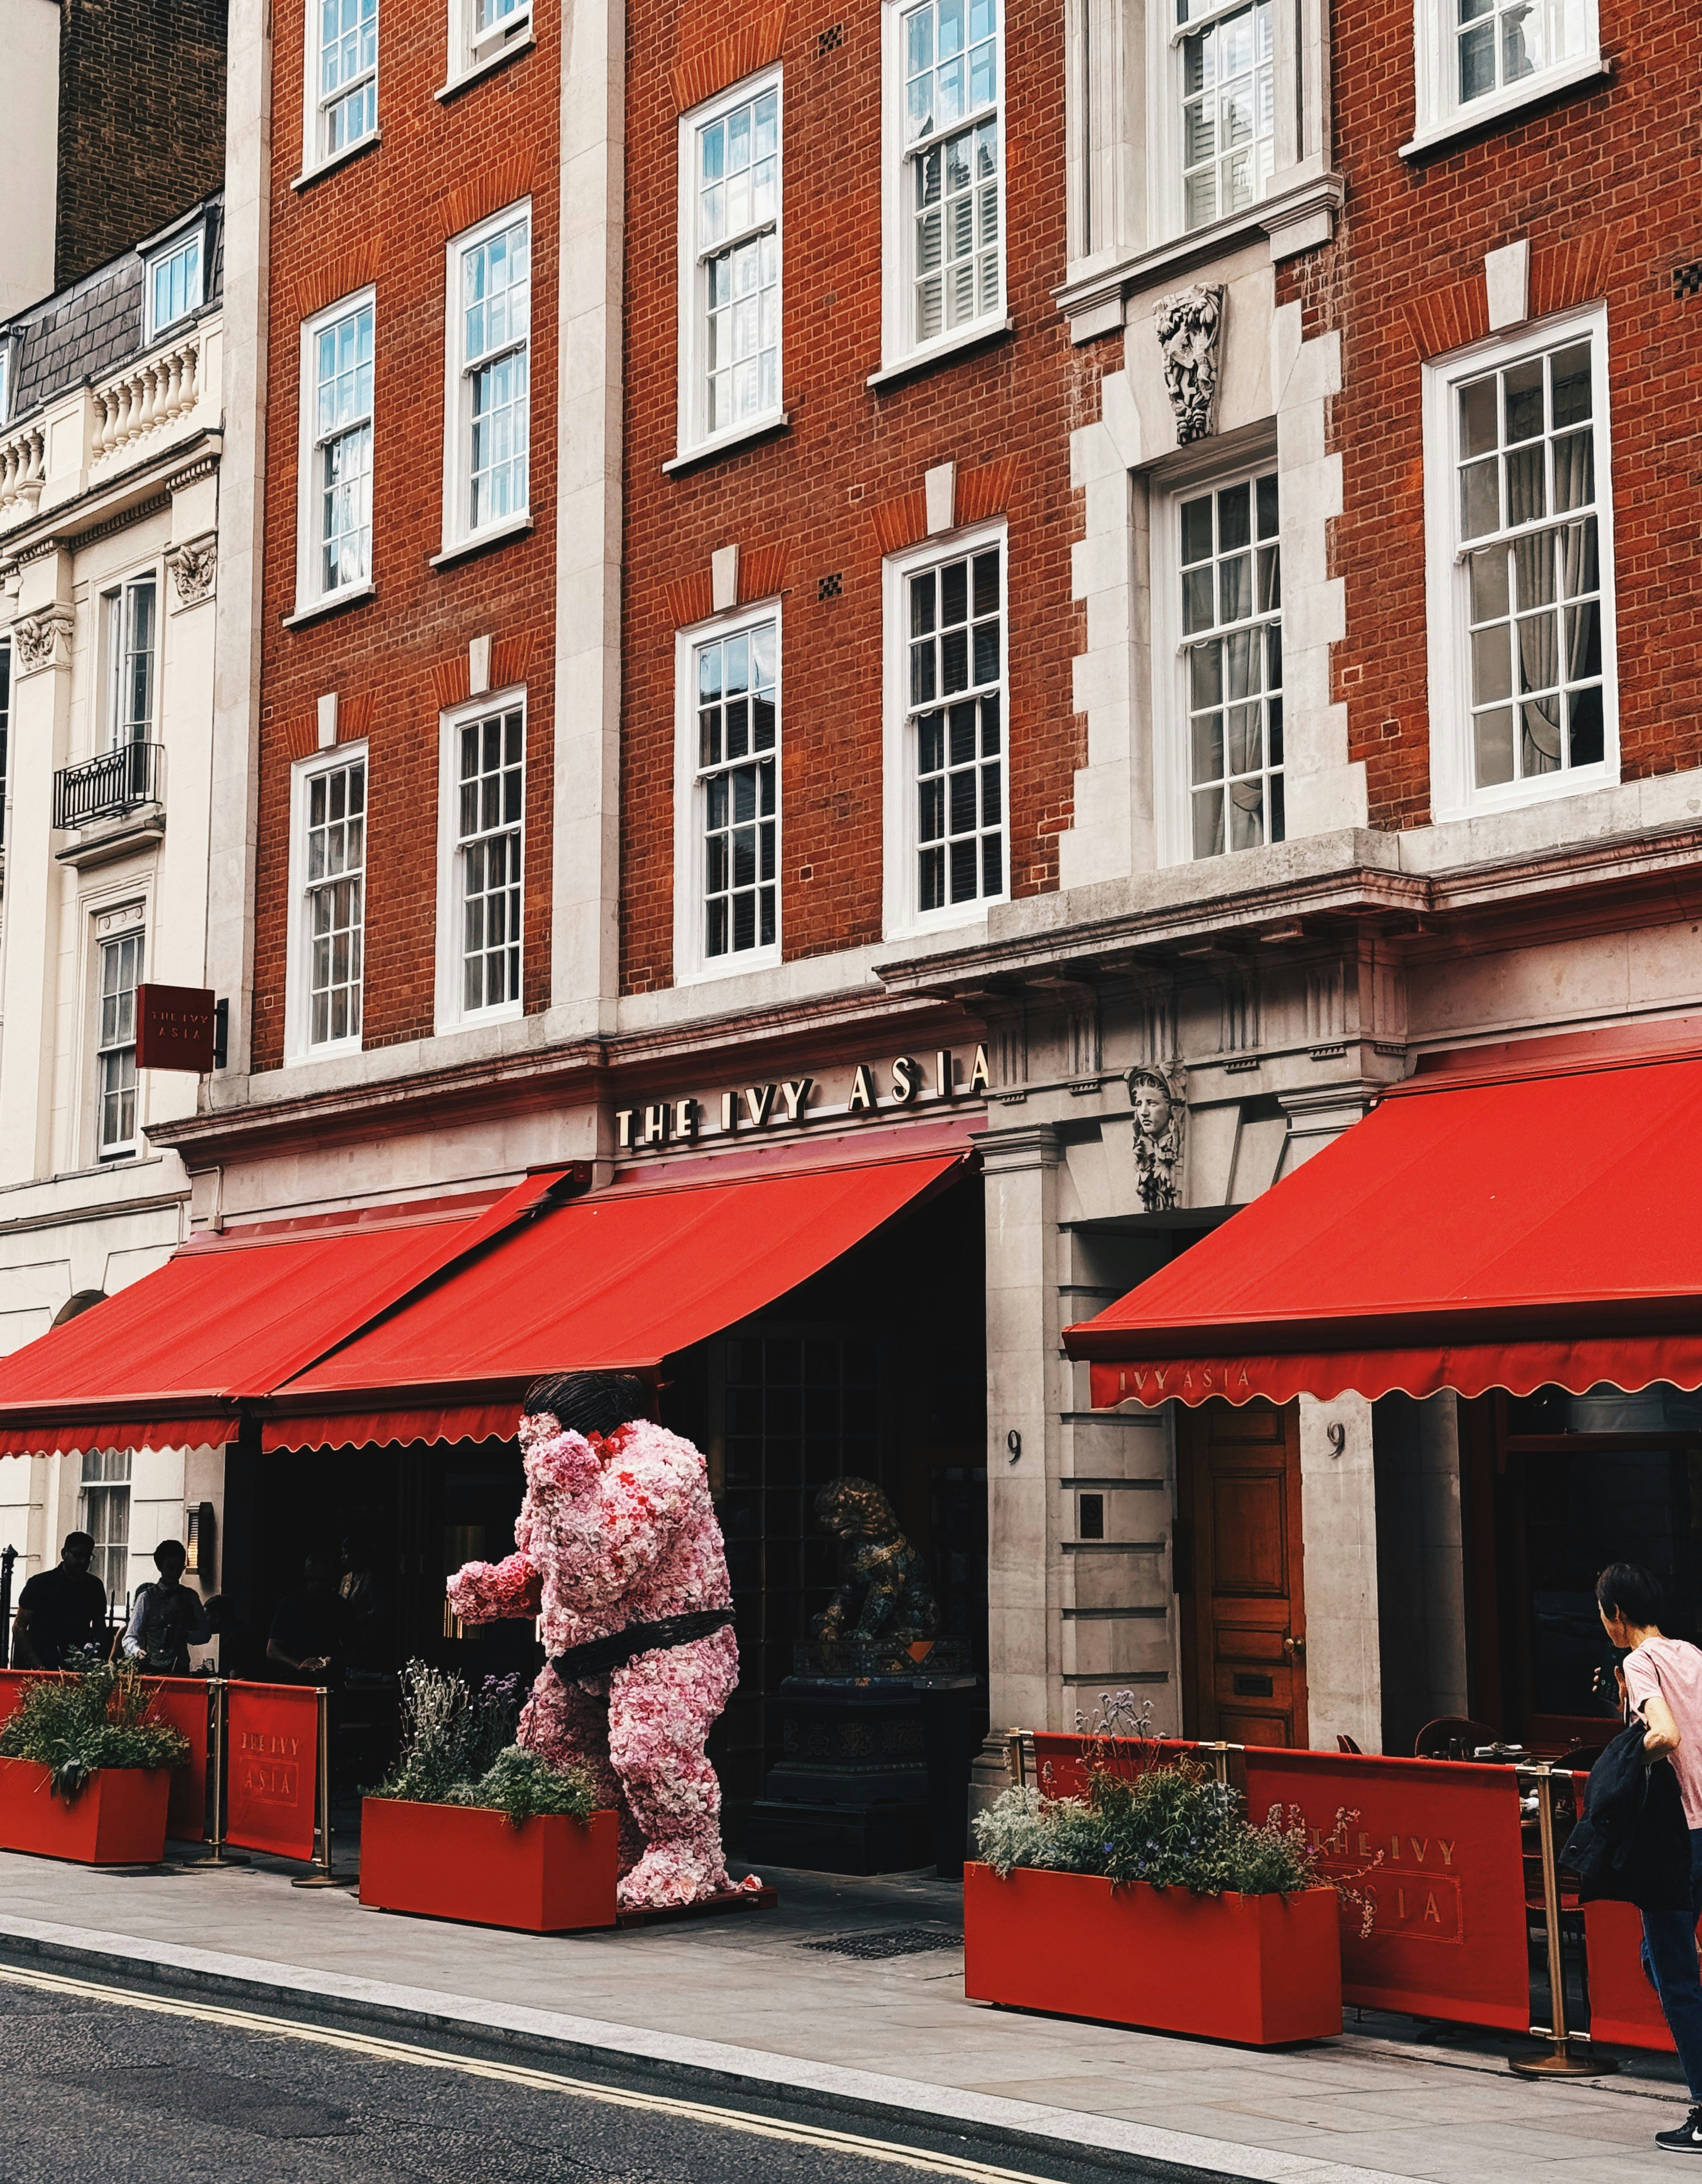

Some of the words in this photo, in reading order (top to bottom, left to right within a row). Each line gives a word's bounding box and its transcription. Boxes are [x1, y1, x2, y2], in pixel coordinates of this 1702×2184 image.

[152, 1011, 177, 1022] THE
[183, 1014, 208, 1024] IVY
[159, 1027, 200, 1039] ASIA
[615, 1099, 697, 1148] THE
[721, 1078, 813, 1131] IVY
[848, 1043, 989, 1112] ASIA
[1119, 1370, 1168, 1391] IVY
[1183, 1368, 1249, 1388] ASIA
[1007, 1429, 1021, 1465] 9
[1327, 1421, 1345, 1459] 9
[242, 1733, 264, 1751] THE
[272, 1736, 299, 1755] IVY
[245, 1767, 289, 1794] ASIA
[1309, 1827, 1372, 1857] THE
[1391, 1836, 1456, 1865] IVY
